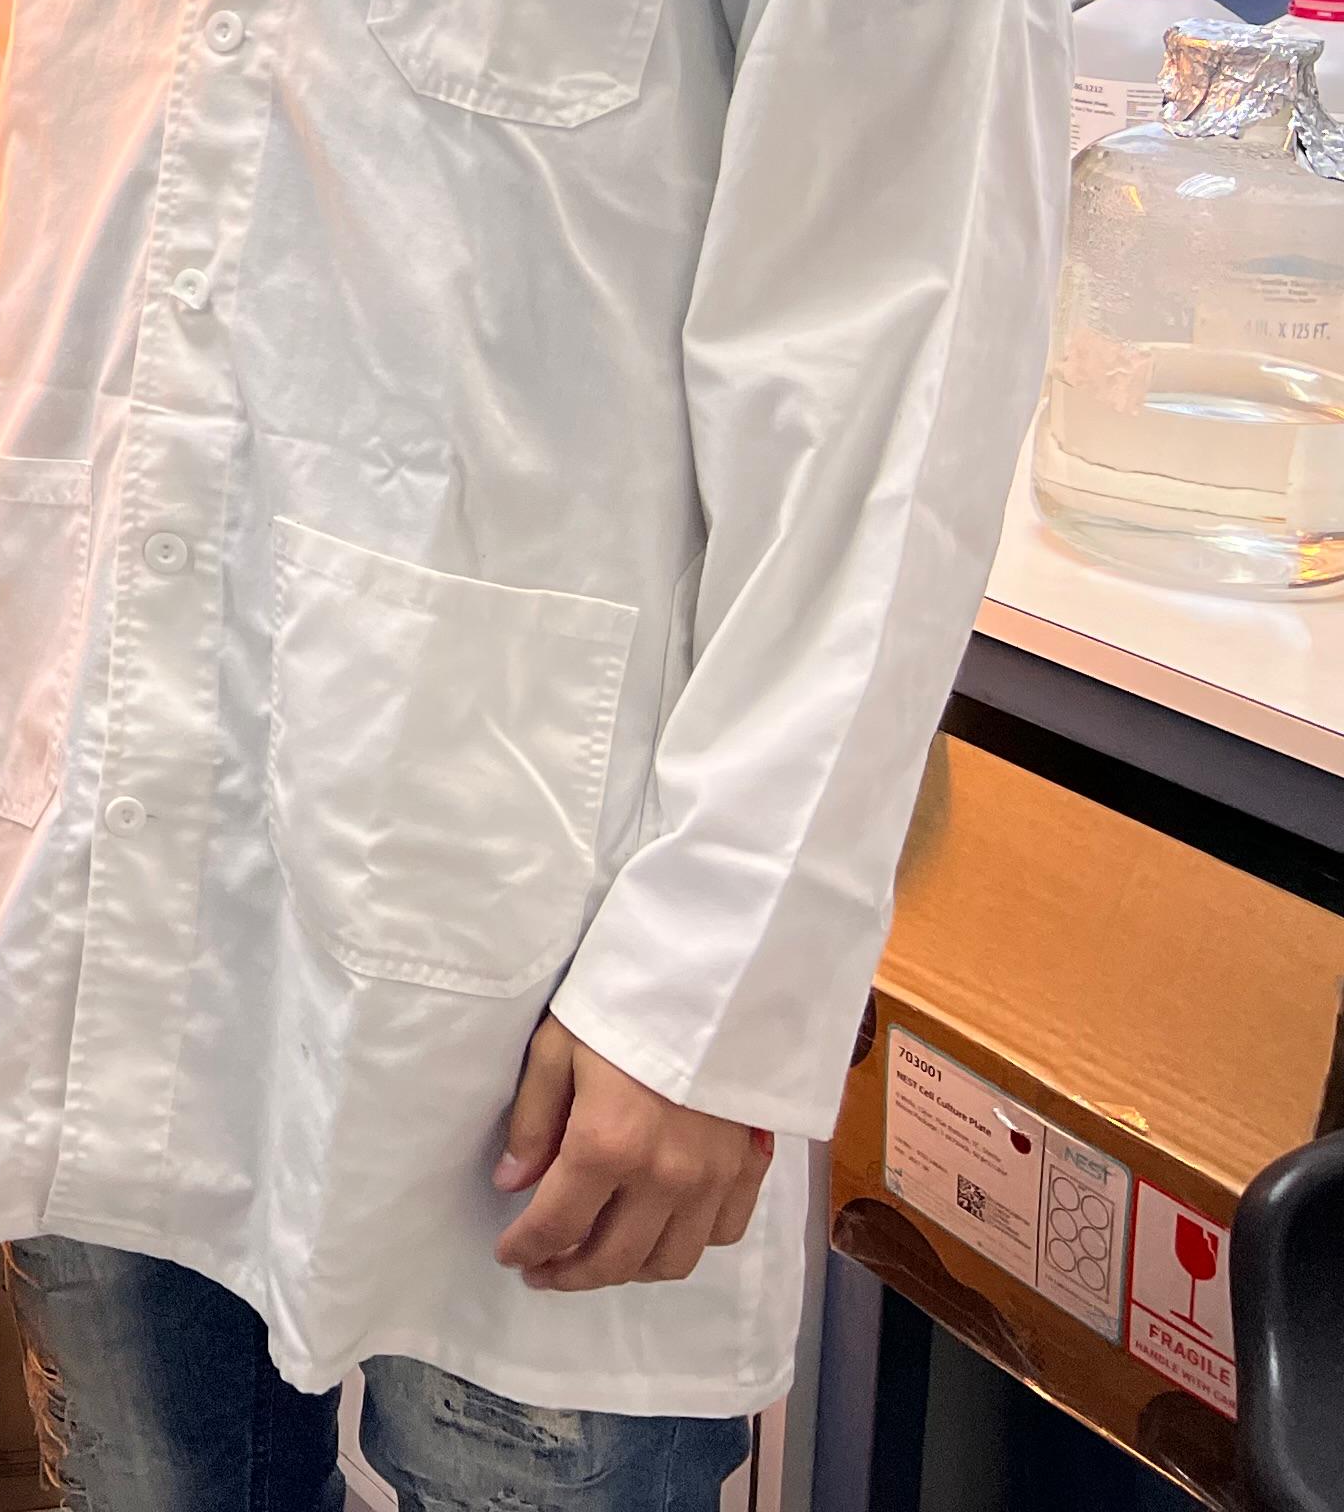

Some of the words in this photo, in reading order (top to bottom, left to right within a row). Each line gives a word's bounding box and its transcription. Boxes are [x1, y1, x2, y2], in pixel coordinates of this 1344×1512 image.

[1292, 323, 1310, 339] 125
[898, 1046, 942, 1082] 703001
[896, 1070, 919, 1090] NEST
[919, 1085, 935, 1102] Cell
[936, 1096, 968, 1122] Culture
[968, 1116, 992, 1138] Plate
[1064, 1147, 1110, 1186] NEST
[1135, 1340, 1178, 1374] HANDLE
[1182, 1369, 1211, 1395] WITH
[1149, 1323, 1231, 1388] FRAGILE
